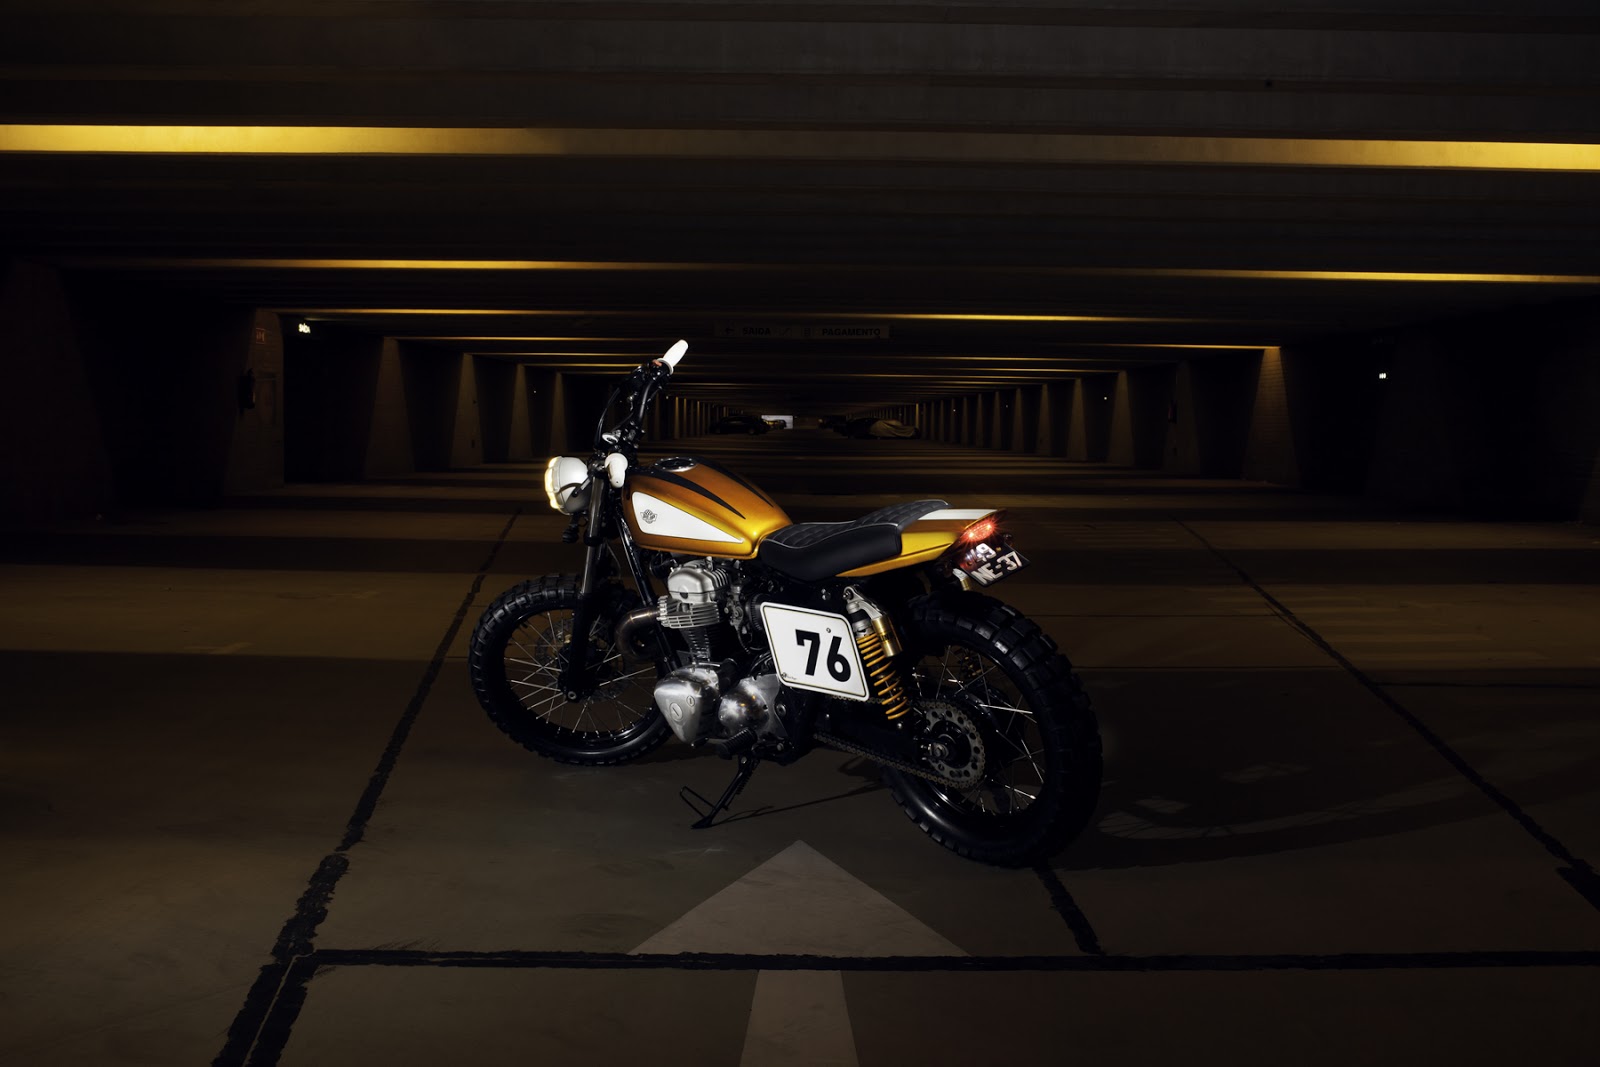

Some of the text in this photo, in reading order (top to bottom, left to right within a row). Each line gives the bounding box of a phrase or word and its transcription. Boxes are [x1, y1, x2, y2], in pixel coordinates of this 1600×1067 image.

[822, 328, 881, 336] PAGAMENTO
[971, 551, 1022, 584] NE-37
[795, 629, 851, 682] 76
